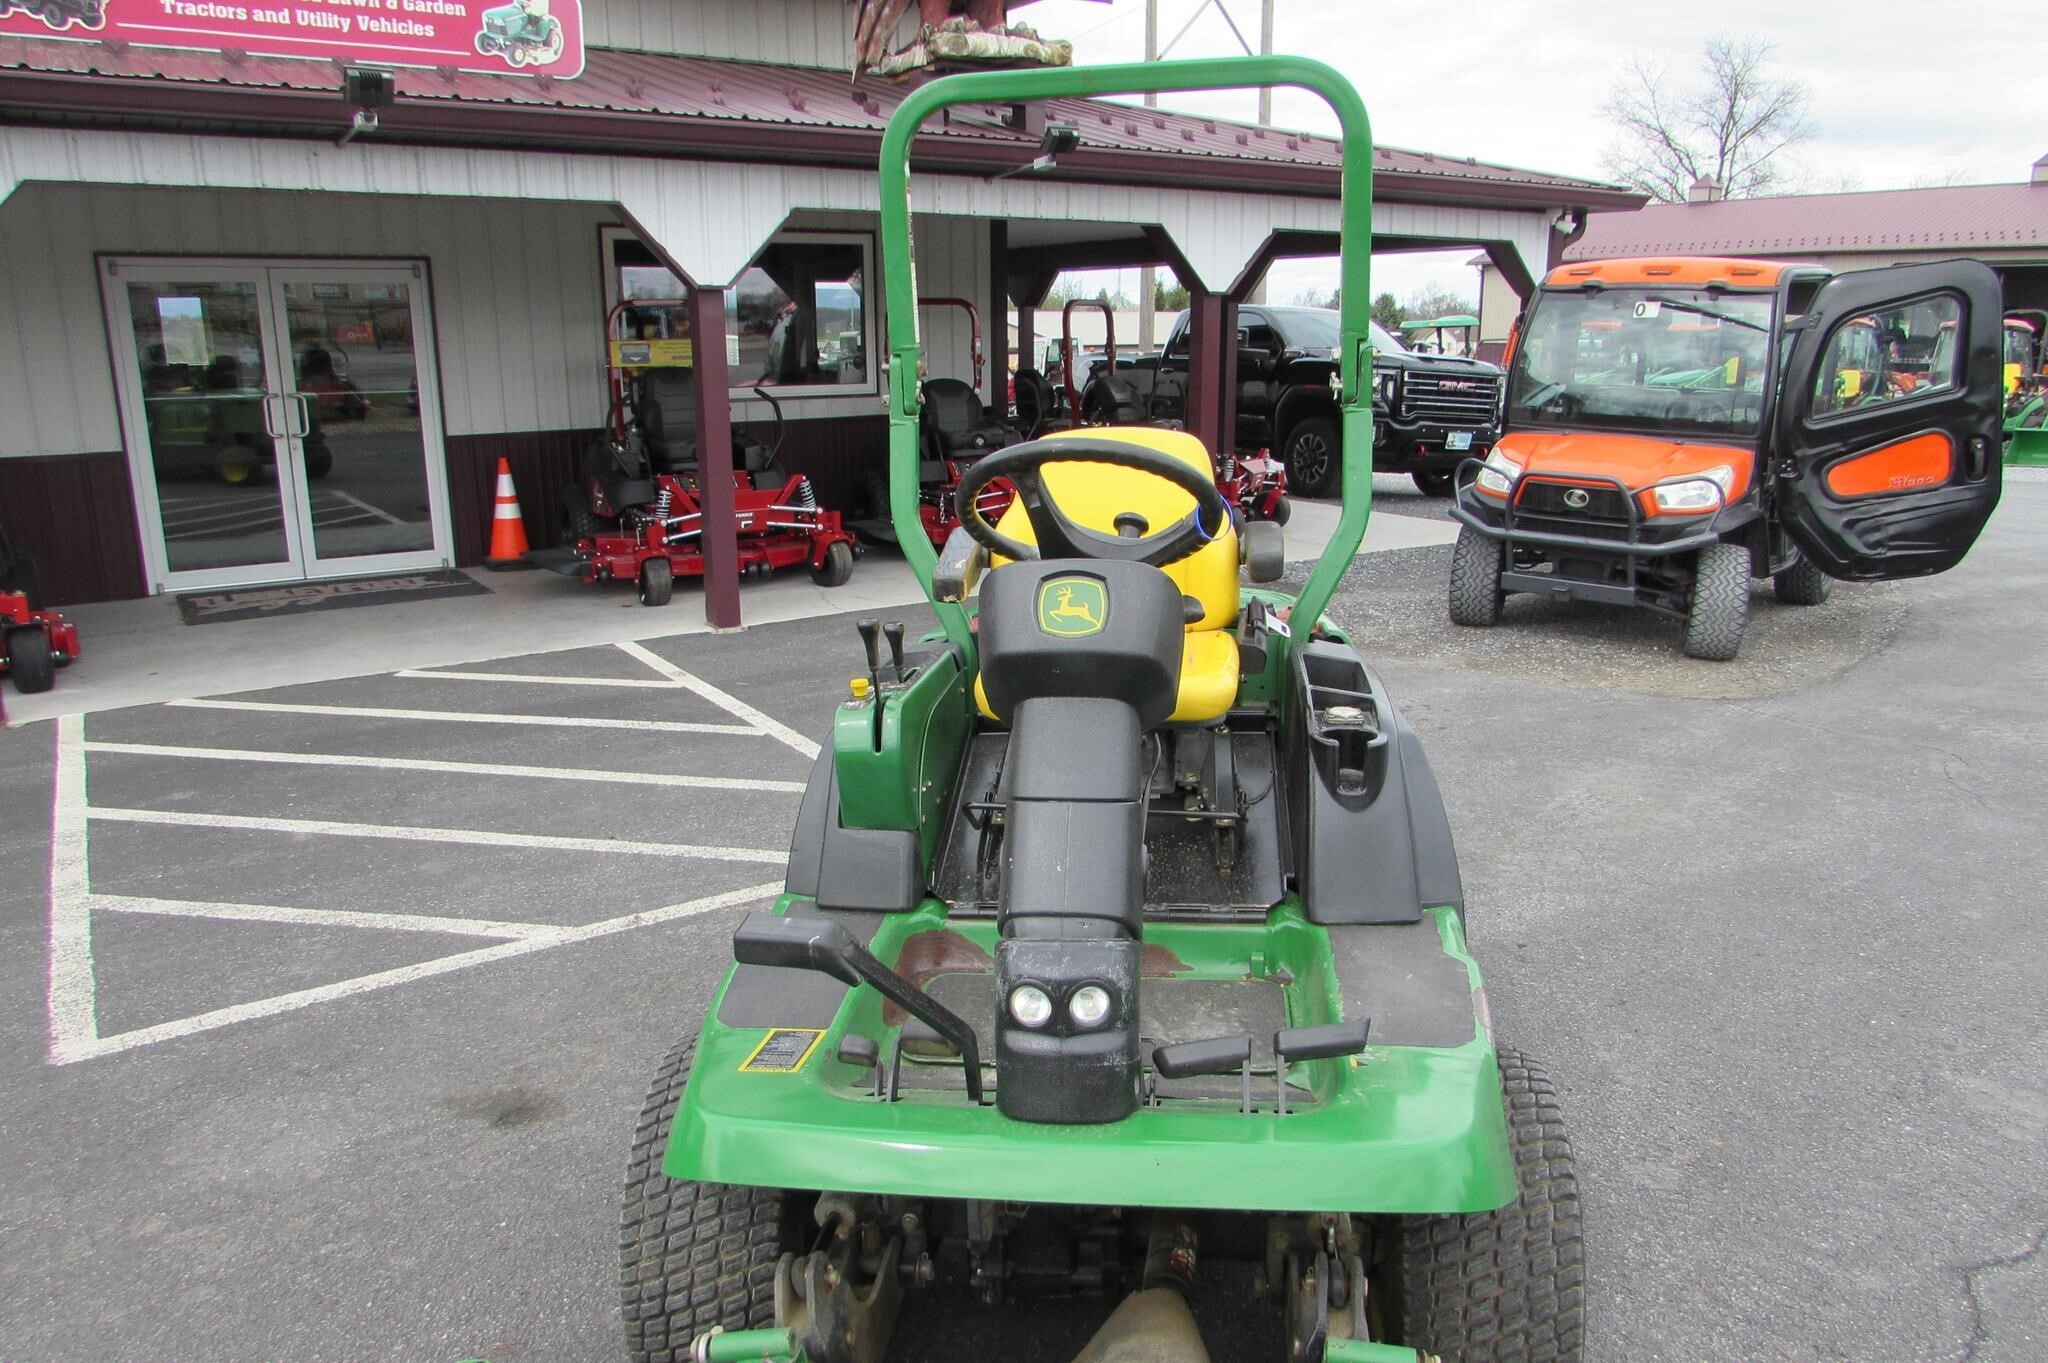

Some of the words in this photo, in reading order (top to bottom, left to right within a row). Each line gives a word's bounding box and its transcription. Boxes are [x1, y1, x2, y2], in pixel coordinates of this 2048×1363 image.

[160, 0, 248, 20] Tractors
[252, 8, 291, 25] and
[295, 9, 351, 33] Utility
[356, 15, 435, 37] Vehicles
[403, 0, 467, 16] Garden
